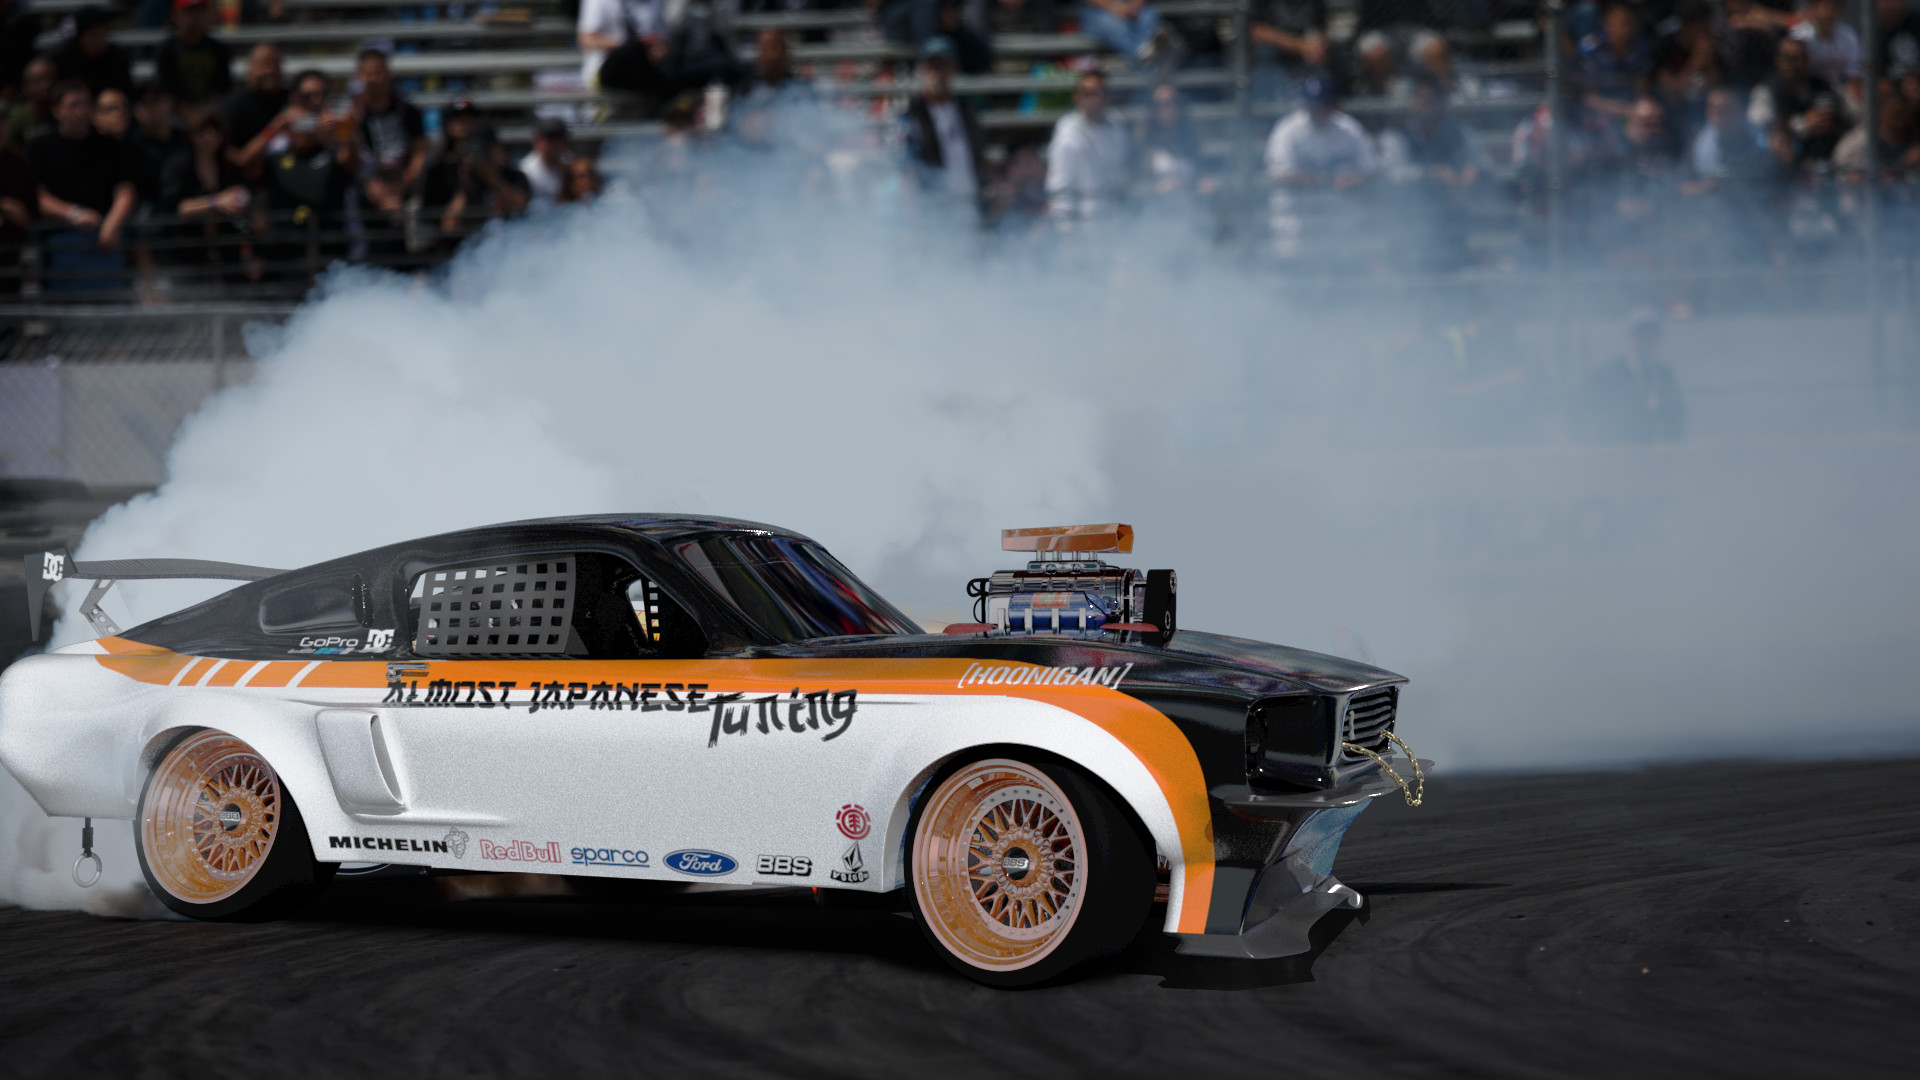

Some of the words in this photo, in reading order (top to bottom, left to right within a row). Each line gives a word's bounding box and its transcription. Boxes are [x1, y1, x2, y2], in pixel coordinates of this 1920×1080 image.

[299, 636, 359, 648] GoPro
[381, 678, 517, 709] ALMOST
[528, 680, 711, 714] JAPANESE
[707, 687, 858, 748] Tuning
[328, 836, 449, 853] MICHELIN
[570, 847, 650, 867] sparco
[678, 852, 722, 873] Ford
[756, 855, 812, 876] BBS
